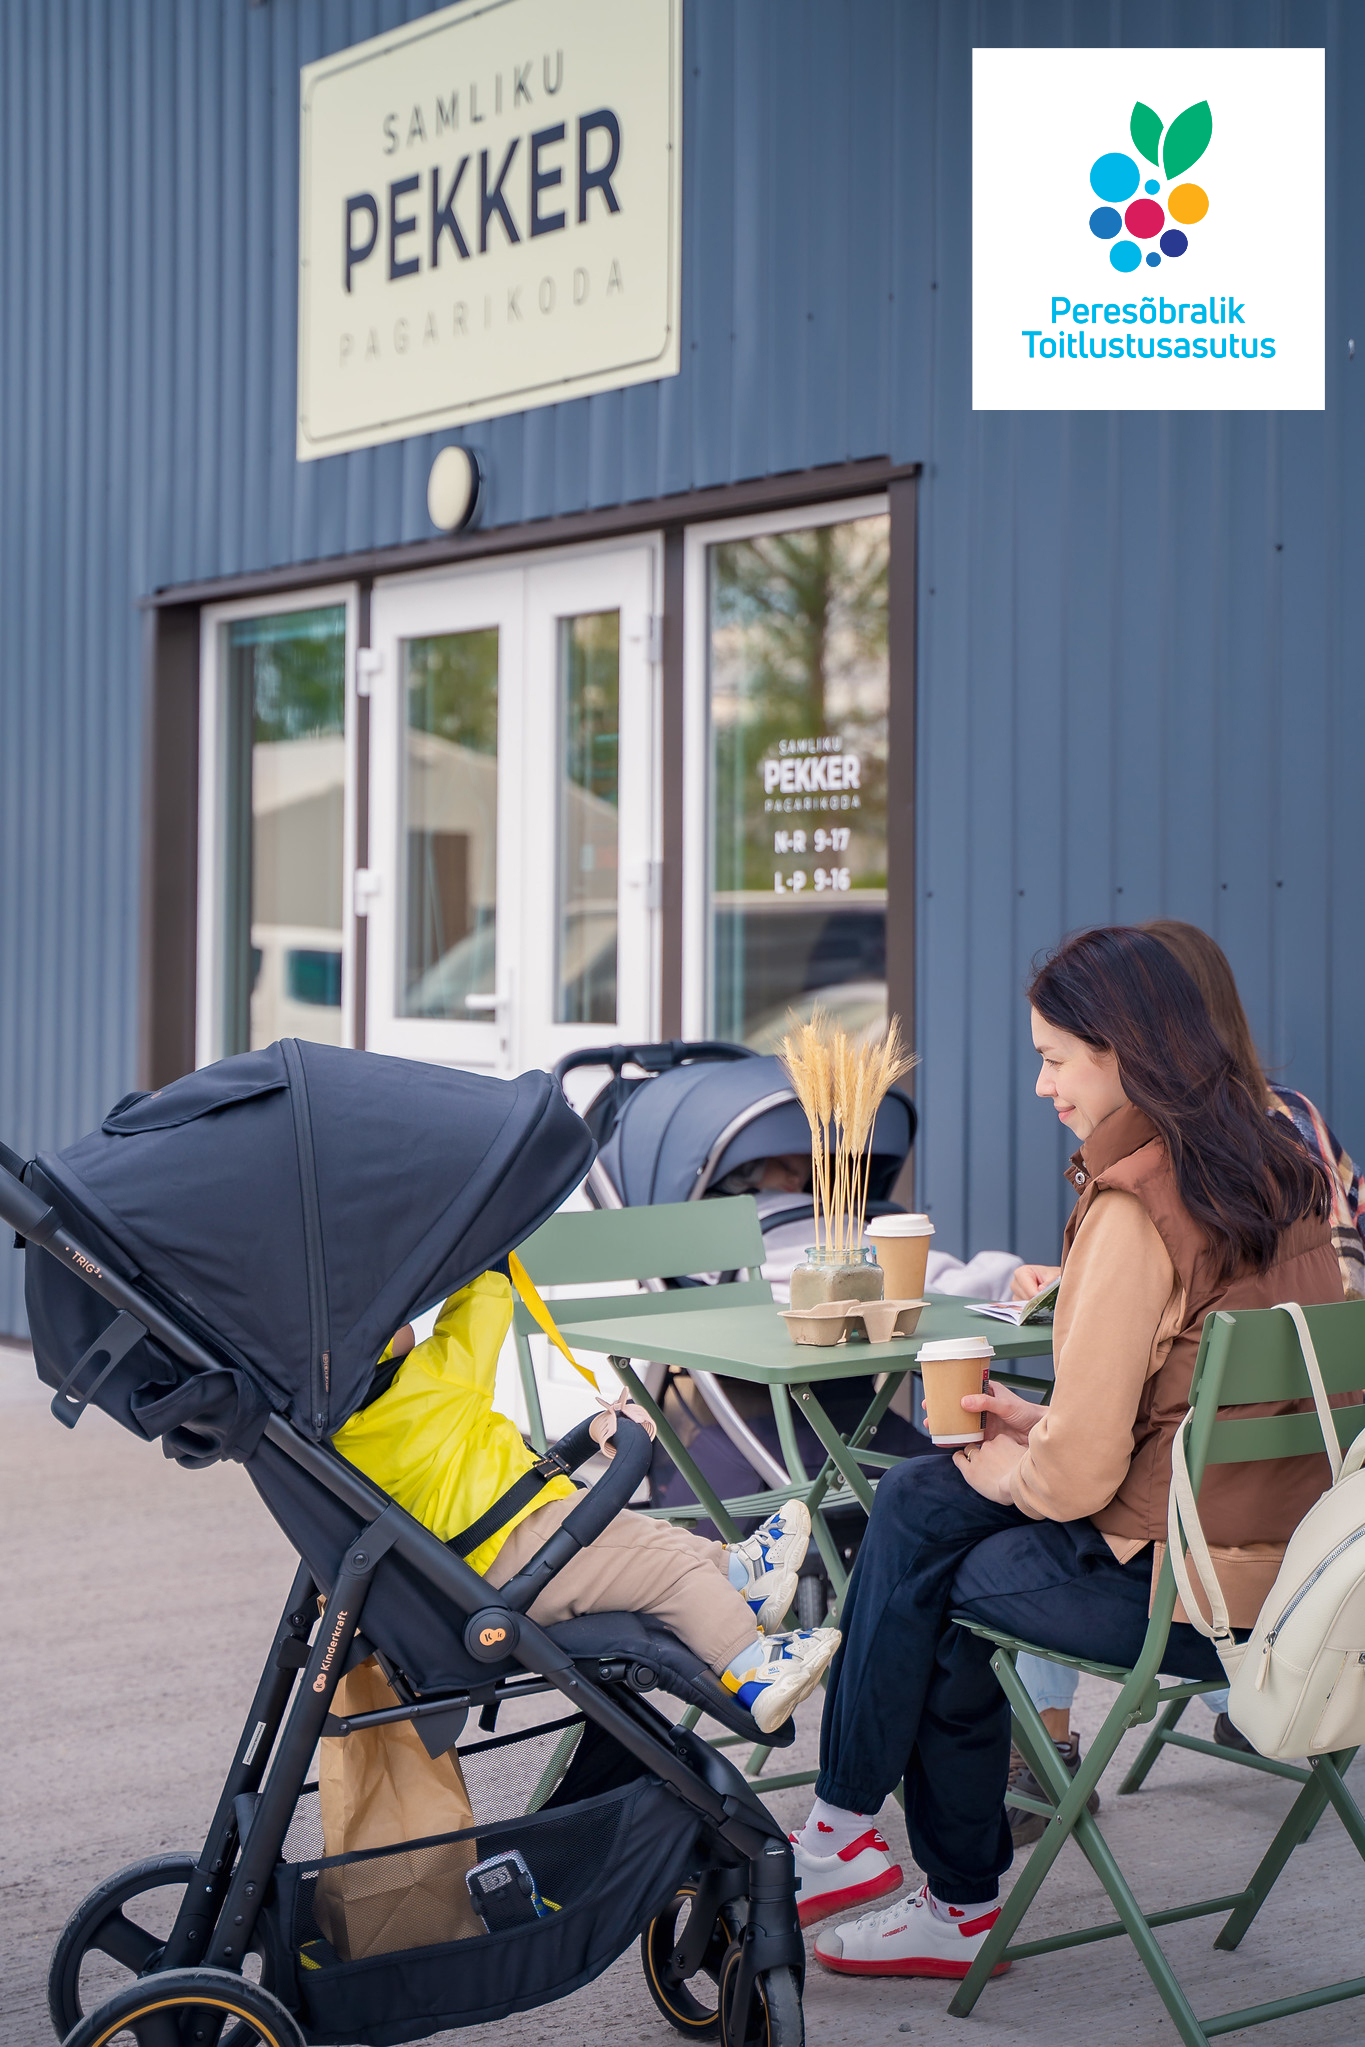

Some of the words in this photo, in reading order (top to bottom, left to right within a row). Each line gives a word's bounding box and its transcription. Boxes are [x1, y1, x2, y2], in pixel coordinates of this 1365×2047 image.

[382, 49, 565, 155] SAMLIKU
[344, 107, 622, 294] PEKKER
[340, 257, 624, 367] PAGARIKODA
[778, 735, 843, 756] SAMLIKU
[764, 755, 861, 794] PEKKER
[774, 829, 807, 854] N-R
[814, 827, 851, 852] 9-17
[774, 870, 807, 894] L-P
[814, 867, 851, 892] 9-16
[320, 1610, 348, 1671] Kinderkraft
